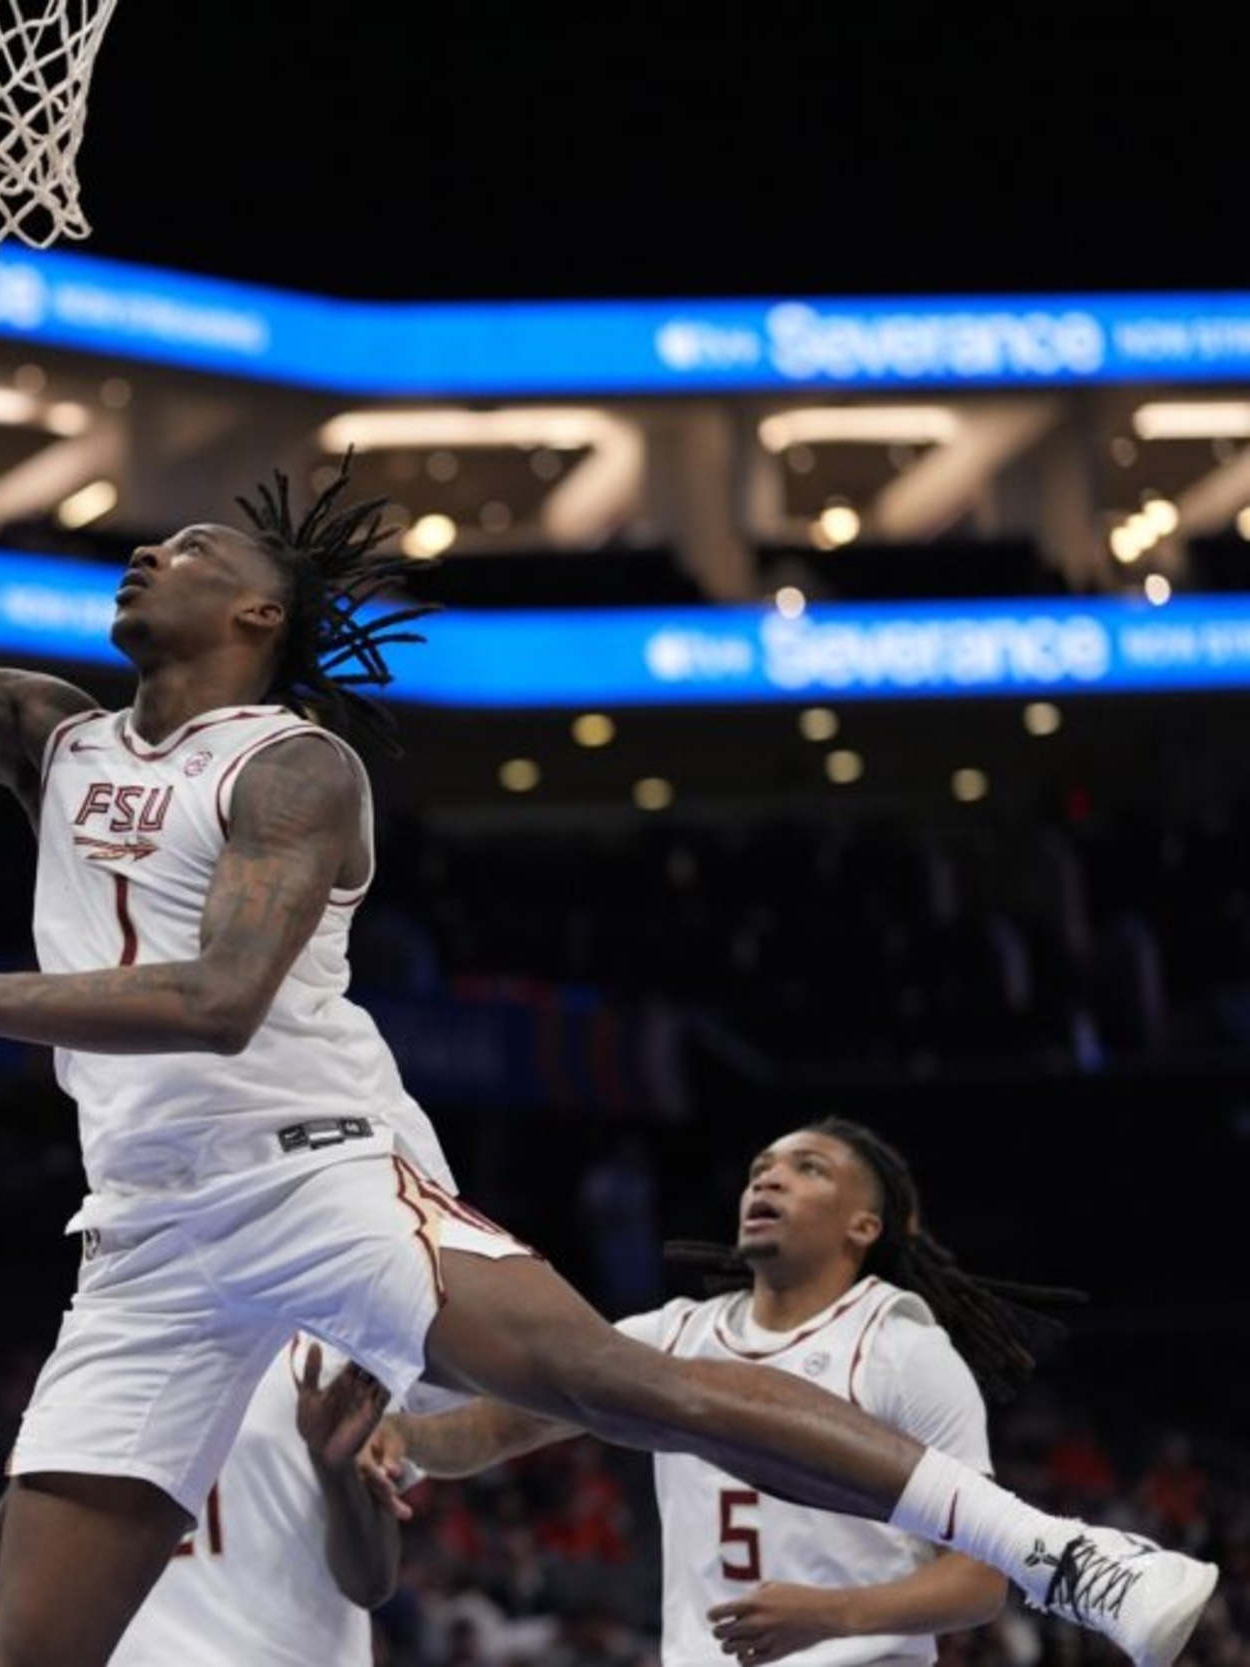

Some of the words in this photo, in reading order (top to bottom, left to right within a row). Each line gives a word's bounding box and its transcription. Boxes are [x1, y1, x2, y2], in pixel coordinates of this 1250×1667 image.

[766, 301, 1105, 379] Severance
[760, 609, 1111, 690] Severance
[74, 782, 174, 833] FSU
[114, 873, 138, 967] 1
[717, 1489, 763, 1581] 5
